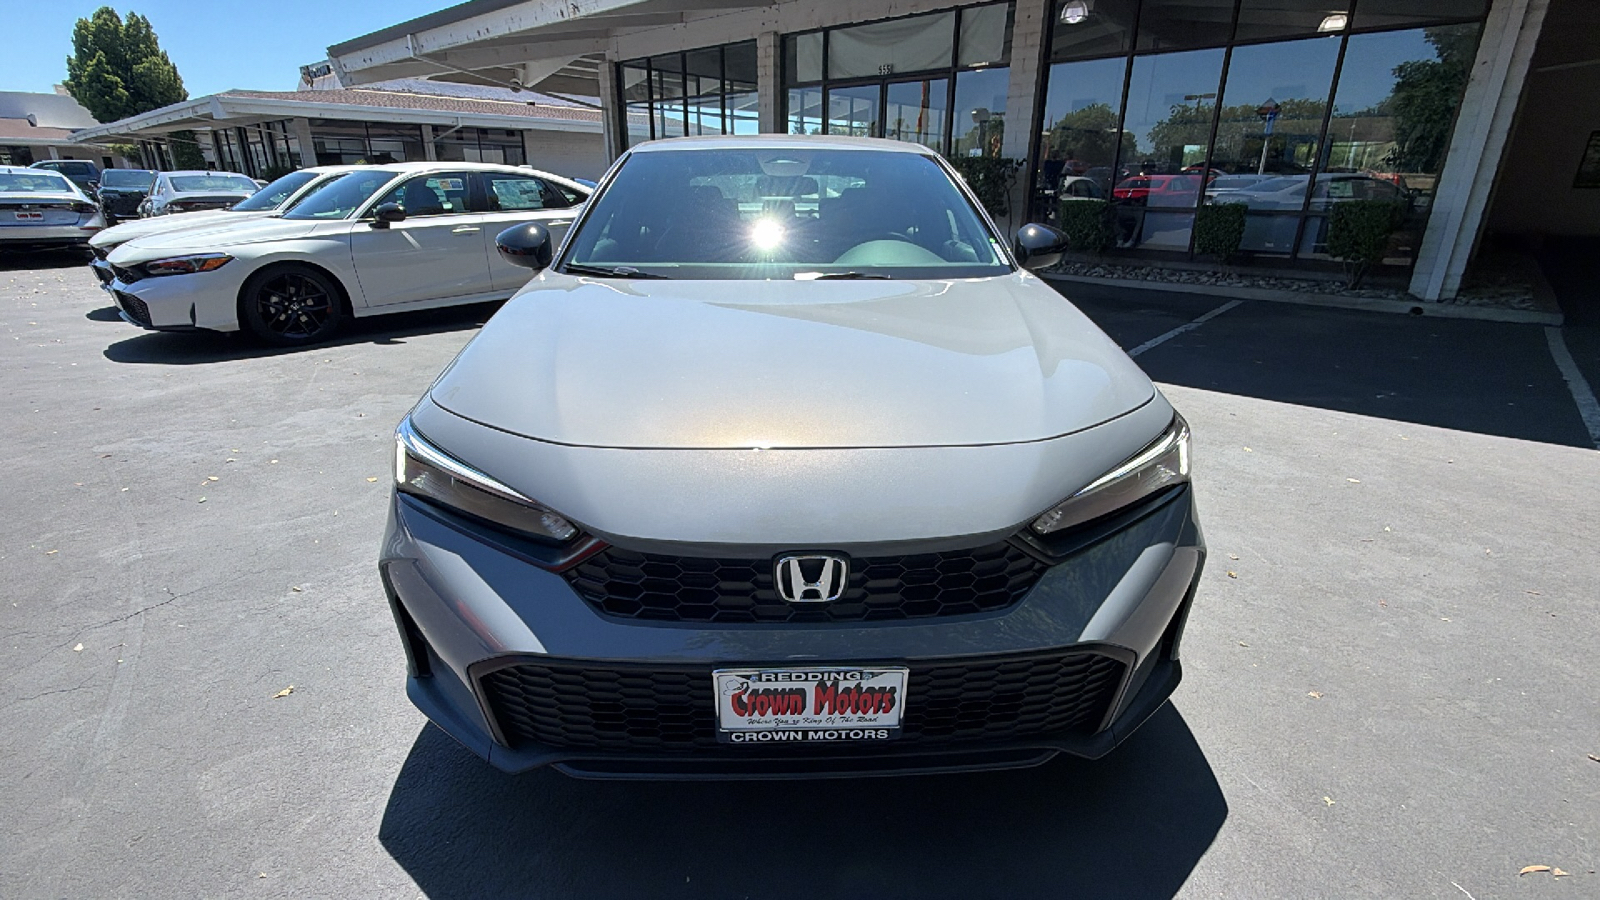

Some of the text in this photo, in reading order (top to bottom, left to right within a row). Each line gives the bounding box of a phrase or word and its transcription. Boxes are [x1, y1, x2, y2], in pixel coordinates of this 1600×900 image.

[761, 671, 861, 682] REDDING
[731, 681, 896, 717] Crown Motors
[801, 716, 823, 725] King
[825, 716, 837, 725] Of
[731, 729, 889, 742] CROWN MOTORS
